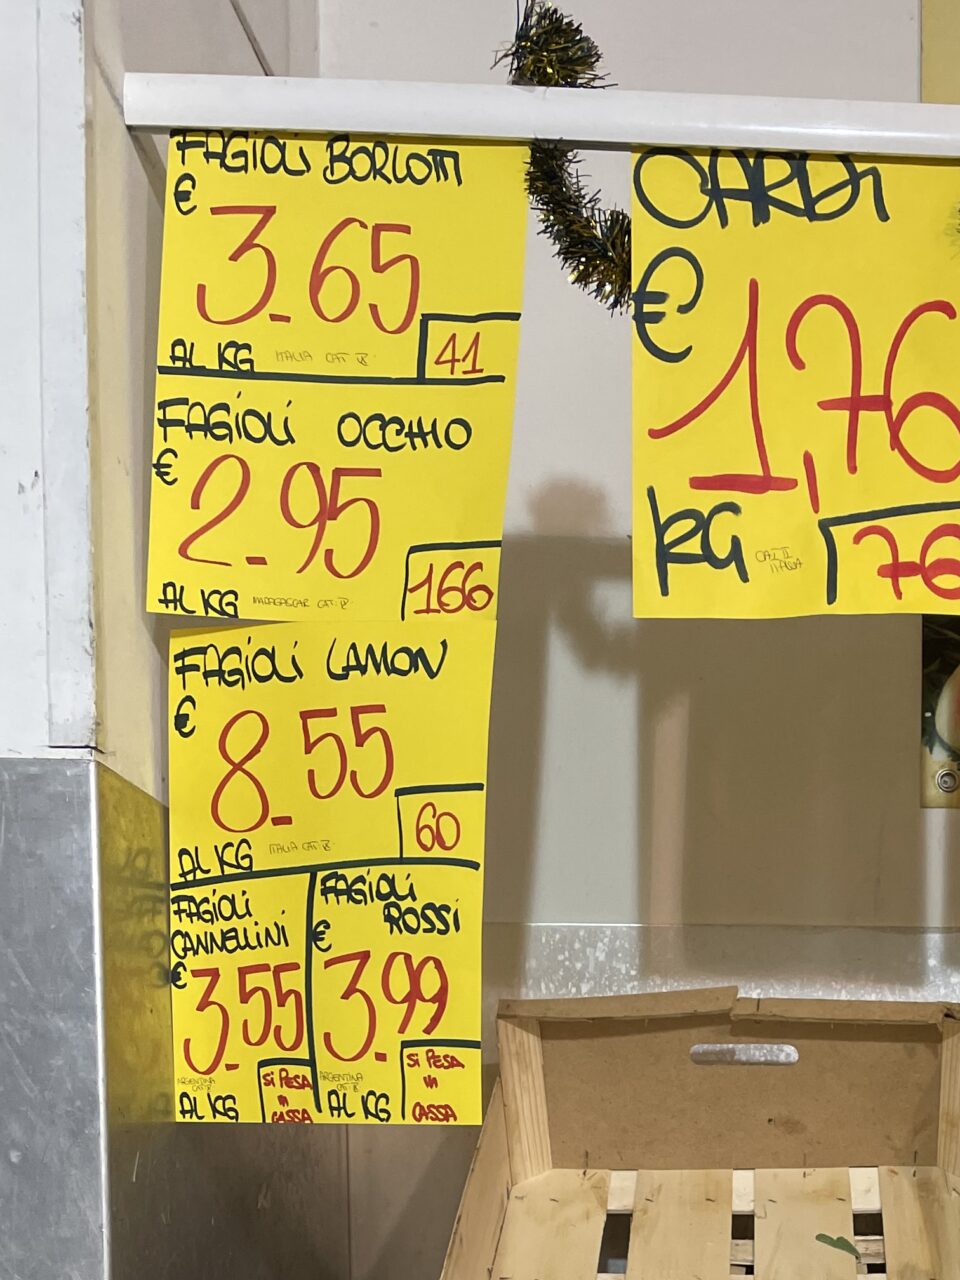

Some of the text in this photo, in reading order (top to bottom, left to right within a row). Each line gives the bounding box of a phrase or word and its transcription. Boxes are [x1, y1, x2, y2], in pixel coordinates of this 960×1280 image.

[170, 338, 196, 369] AL
[218, 340, 254, 372] KG
[434, 332, 484, 375] 41
[337, 412, 473, 452] OCCHIO
[158, 581, 194, 614] AL
[200, 589, 239, 619] KG
[407, 561, 494, 615] 166
[326, 638, 448, 680] LAMON
[415, 801, 461, 852] 60
[178, 847, 211, 881] AL
[215, 838, 253, 876] KG
[179, 1092, 239, 1122] AL KG
[328, 1089, 391, 1122] AL KG
[412, 1102, 458, 1123] CASSA
